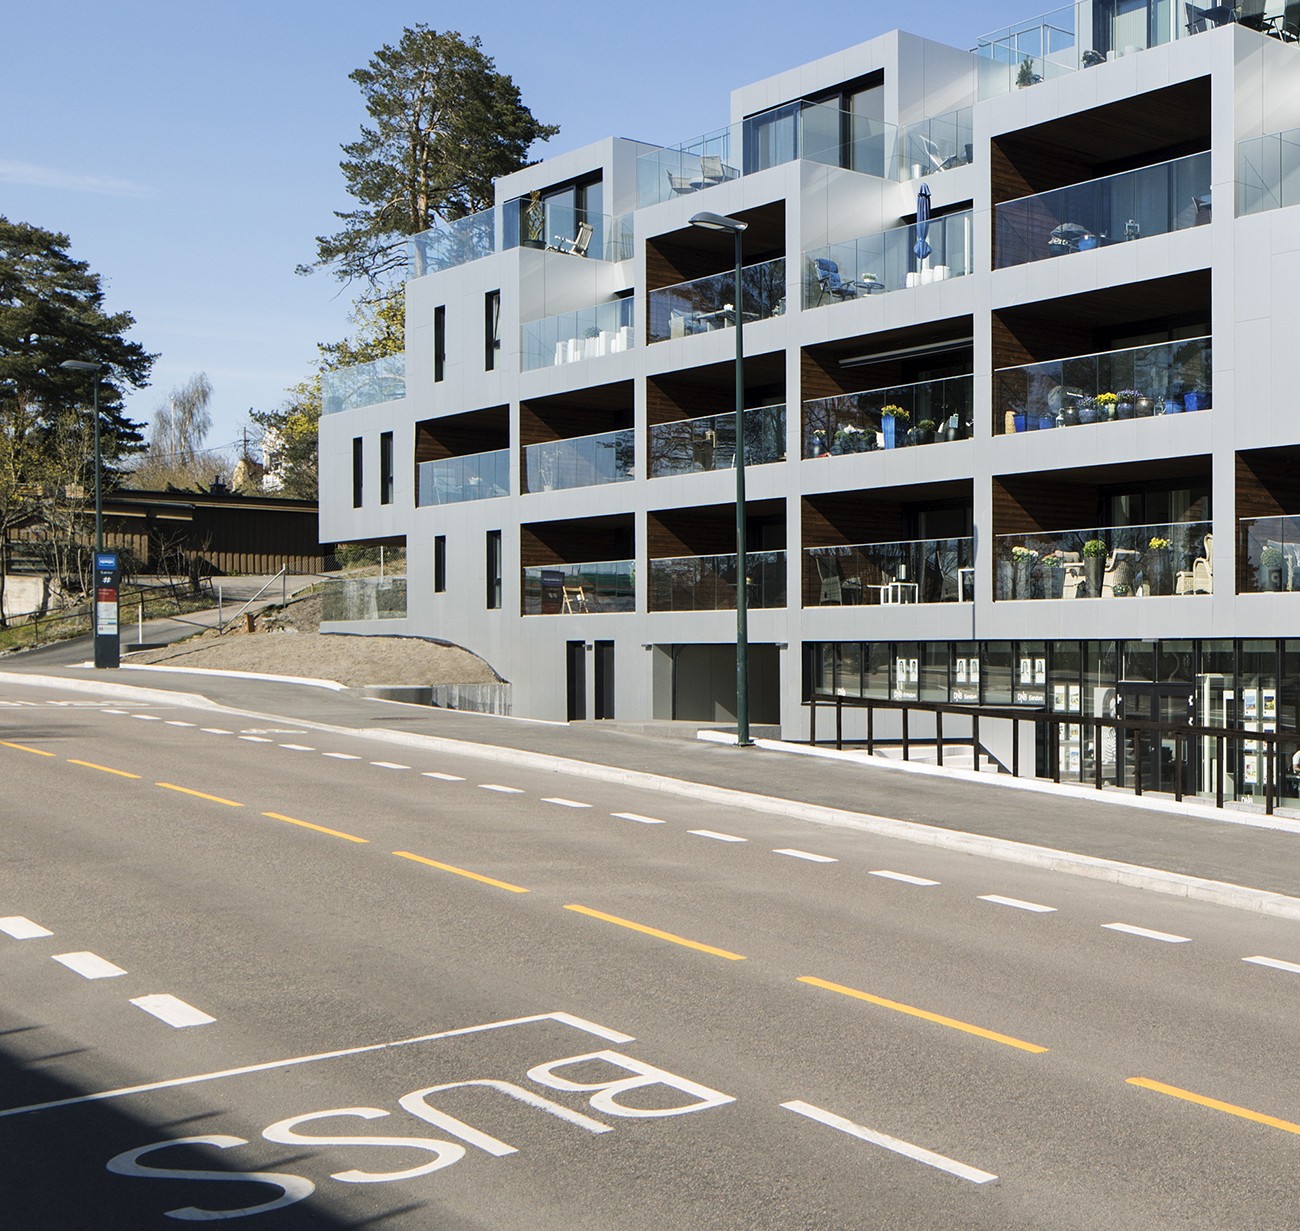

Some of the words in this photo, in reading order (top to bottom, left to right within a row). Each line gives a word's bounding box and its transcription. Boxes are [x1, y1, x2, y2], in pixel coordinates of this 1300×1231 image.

[953, 689, 962, 702] DNB
[1017, 691, 1027, 703] DNB
[106, 1050, 737, 1221] BUSS
